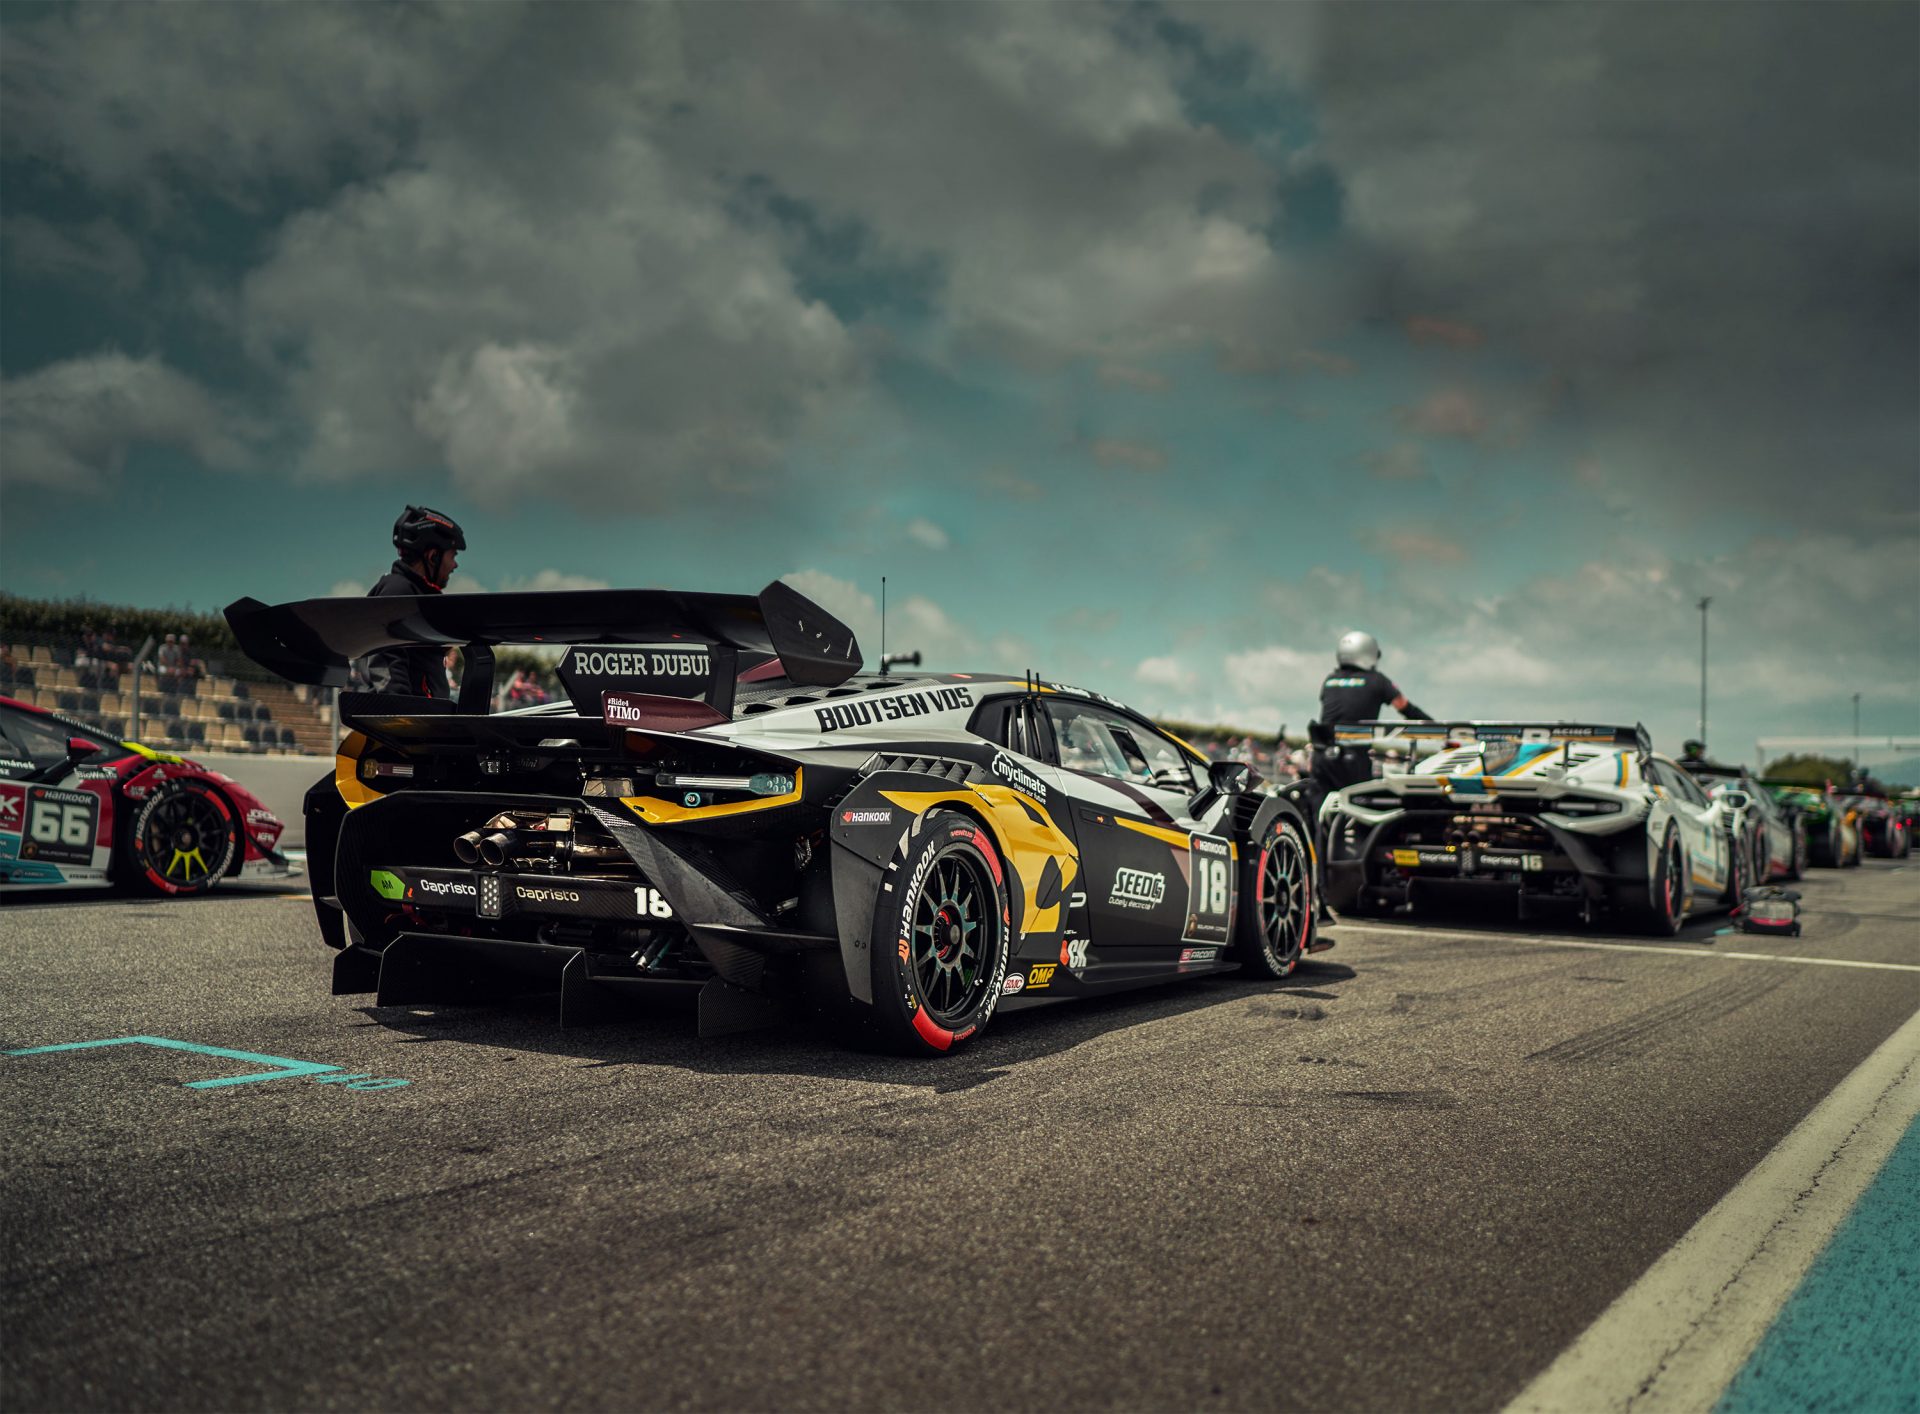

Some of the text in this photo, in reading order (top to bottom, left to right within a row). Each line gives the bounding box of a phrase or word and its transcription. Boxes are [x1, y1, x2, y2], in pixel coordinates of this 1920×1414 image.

[574, 652, 711, 675] ROGER DUBUI
[607, 698, 629, 707] #Ride4
[814, 686, 974, 733] BOUTSEN VDS
[607, 705, 640, 721] TIMO
[998, 760, 1046, 797] myclimate
[30, 800, 92, 846] 66
[1521, 854, 1543, 871] 16
[382, 880, 394, 890] AM
[1199, 857, 1227, 914] 18
[420, 879, 673, 919] Capristo Capristo 18
[1004, 979, 1023, 989] BMC
[1029, 967, 1055, 985] OMP
